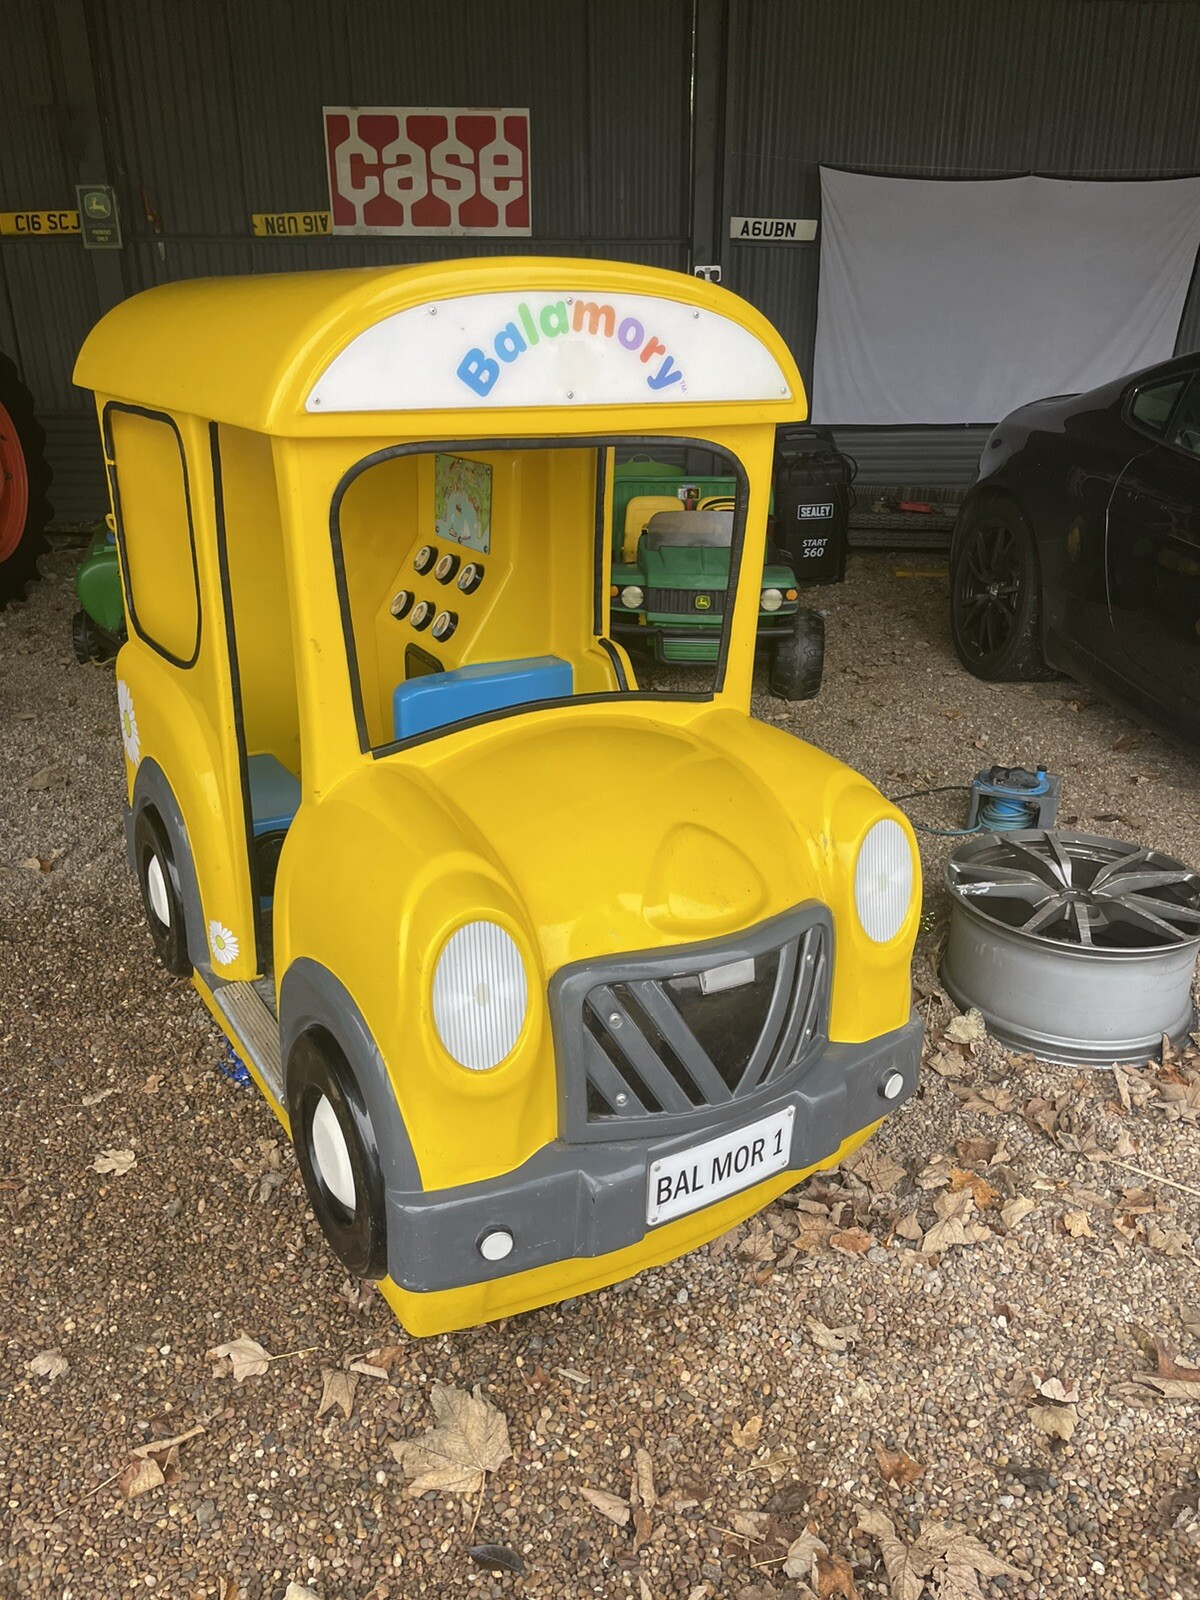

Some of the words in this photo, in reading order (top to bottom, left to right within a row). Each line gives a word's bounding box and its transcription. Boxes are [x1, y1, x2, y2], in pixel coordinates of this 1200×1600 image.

[335, 117, 523, 225] case
[14, 213, 42, 232] C16
[47, 212, 81, 231] SCJ
[264, 215, 299, 235] UBN
[302, 214, 329, 233] A16
[740, 219, 797, 238] A6UBN
[456, 300, 683, 398] Balamory
[800, 505, 831, 518] SEALEY
[802, 538, 828, 548] START
[802, 547, 825, 558] 560
[656, 1164, 704, 1206] BAL
[711, 1137, 766, 1185] MOR
[772, 1128, 784, 1156] 1
